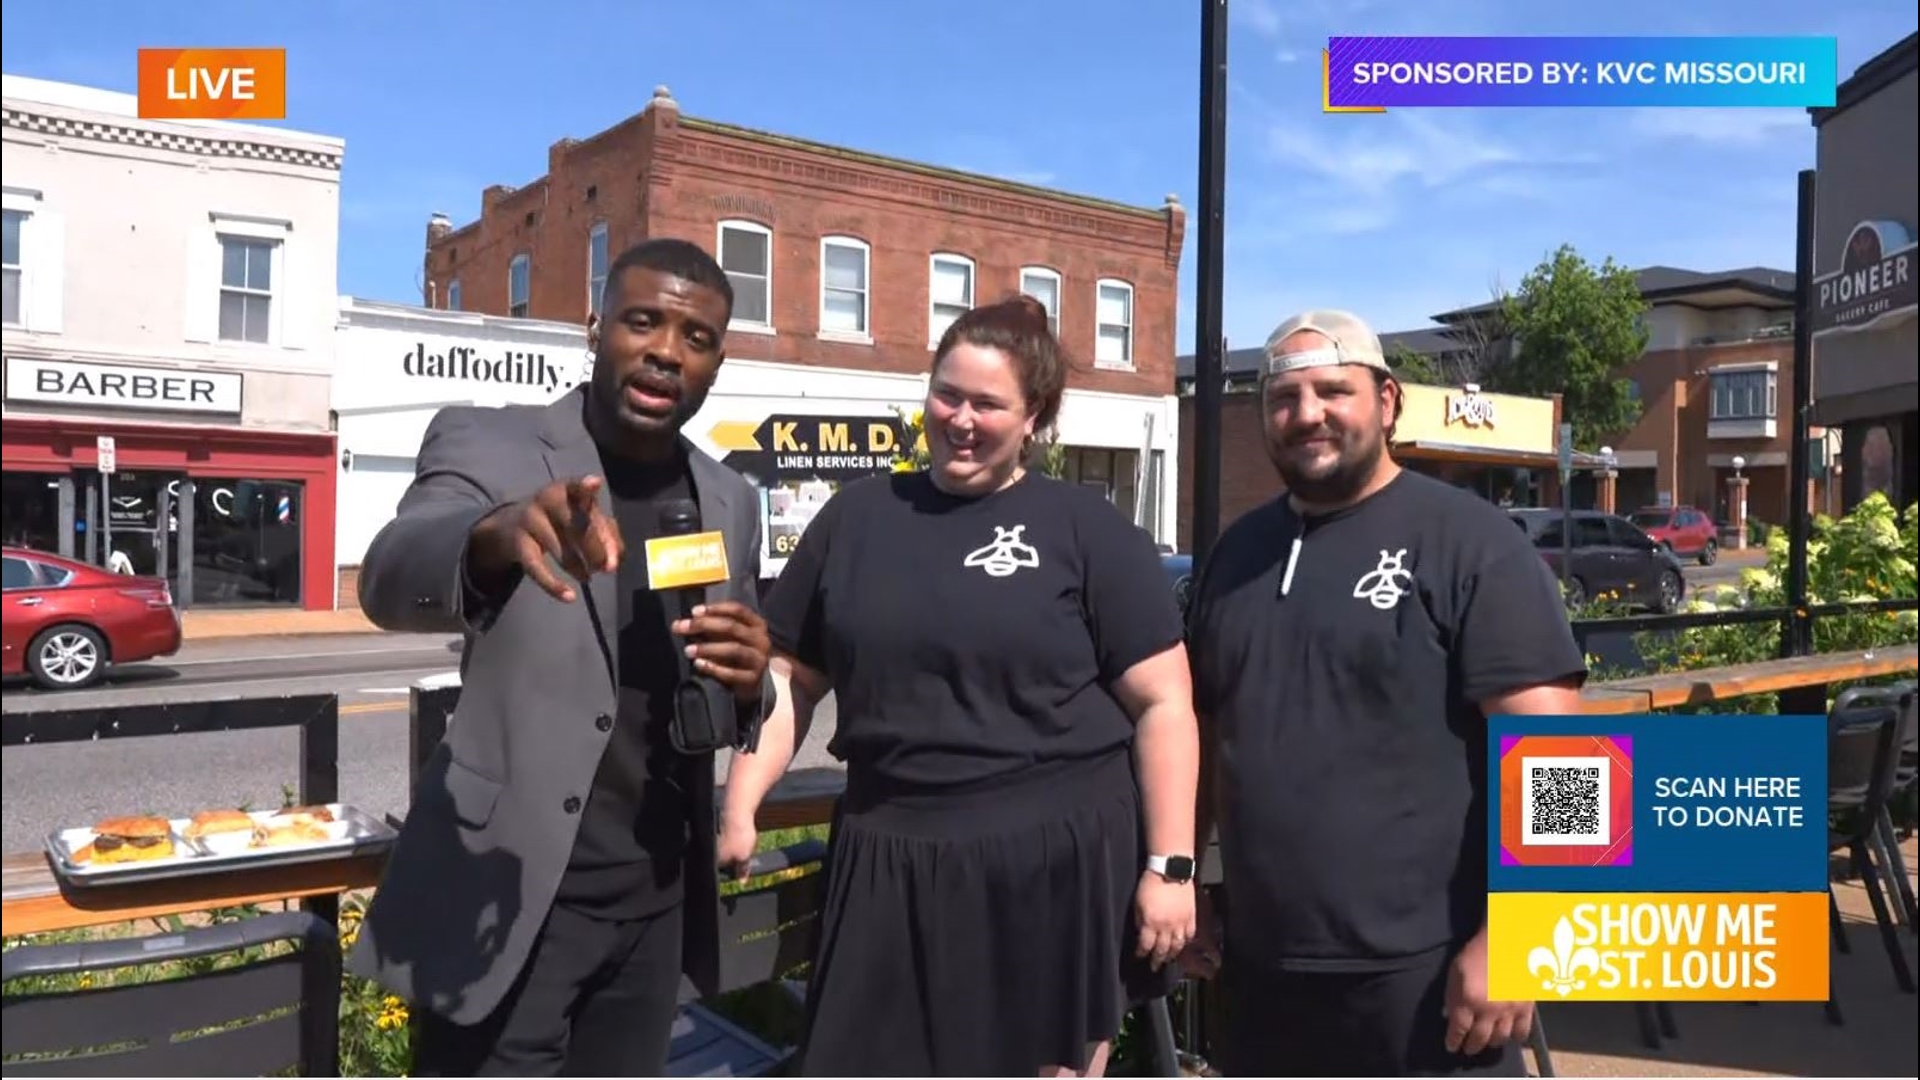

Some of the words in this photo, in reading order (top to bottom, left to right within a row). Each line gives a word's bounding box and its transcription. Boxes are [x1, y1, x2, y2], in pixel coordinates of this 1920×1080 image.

[1820, 255, 1908, 308] PIONEER
[403, 342, 571, 393] daffodilly.
[36, 368, 215, 403] BARBER
[773, 422, 808, 452] K.
[819, 422, 857, 452] M.
[868, 423, 900, 452] D.
[777, 456, 813, 468] LINEN
[816, 456, 873, 468] SERVICES
